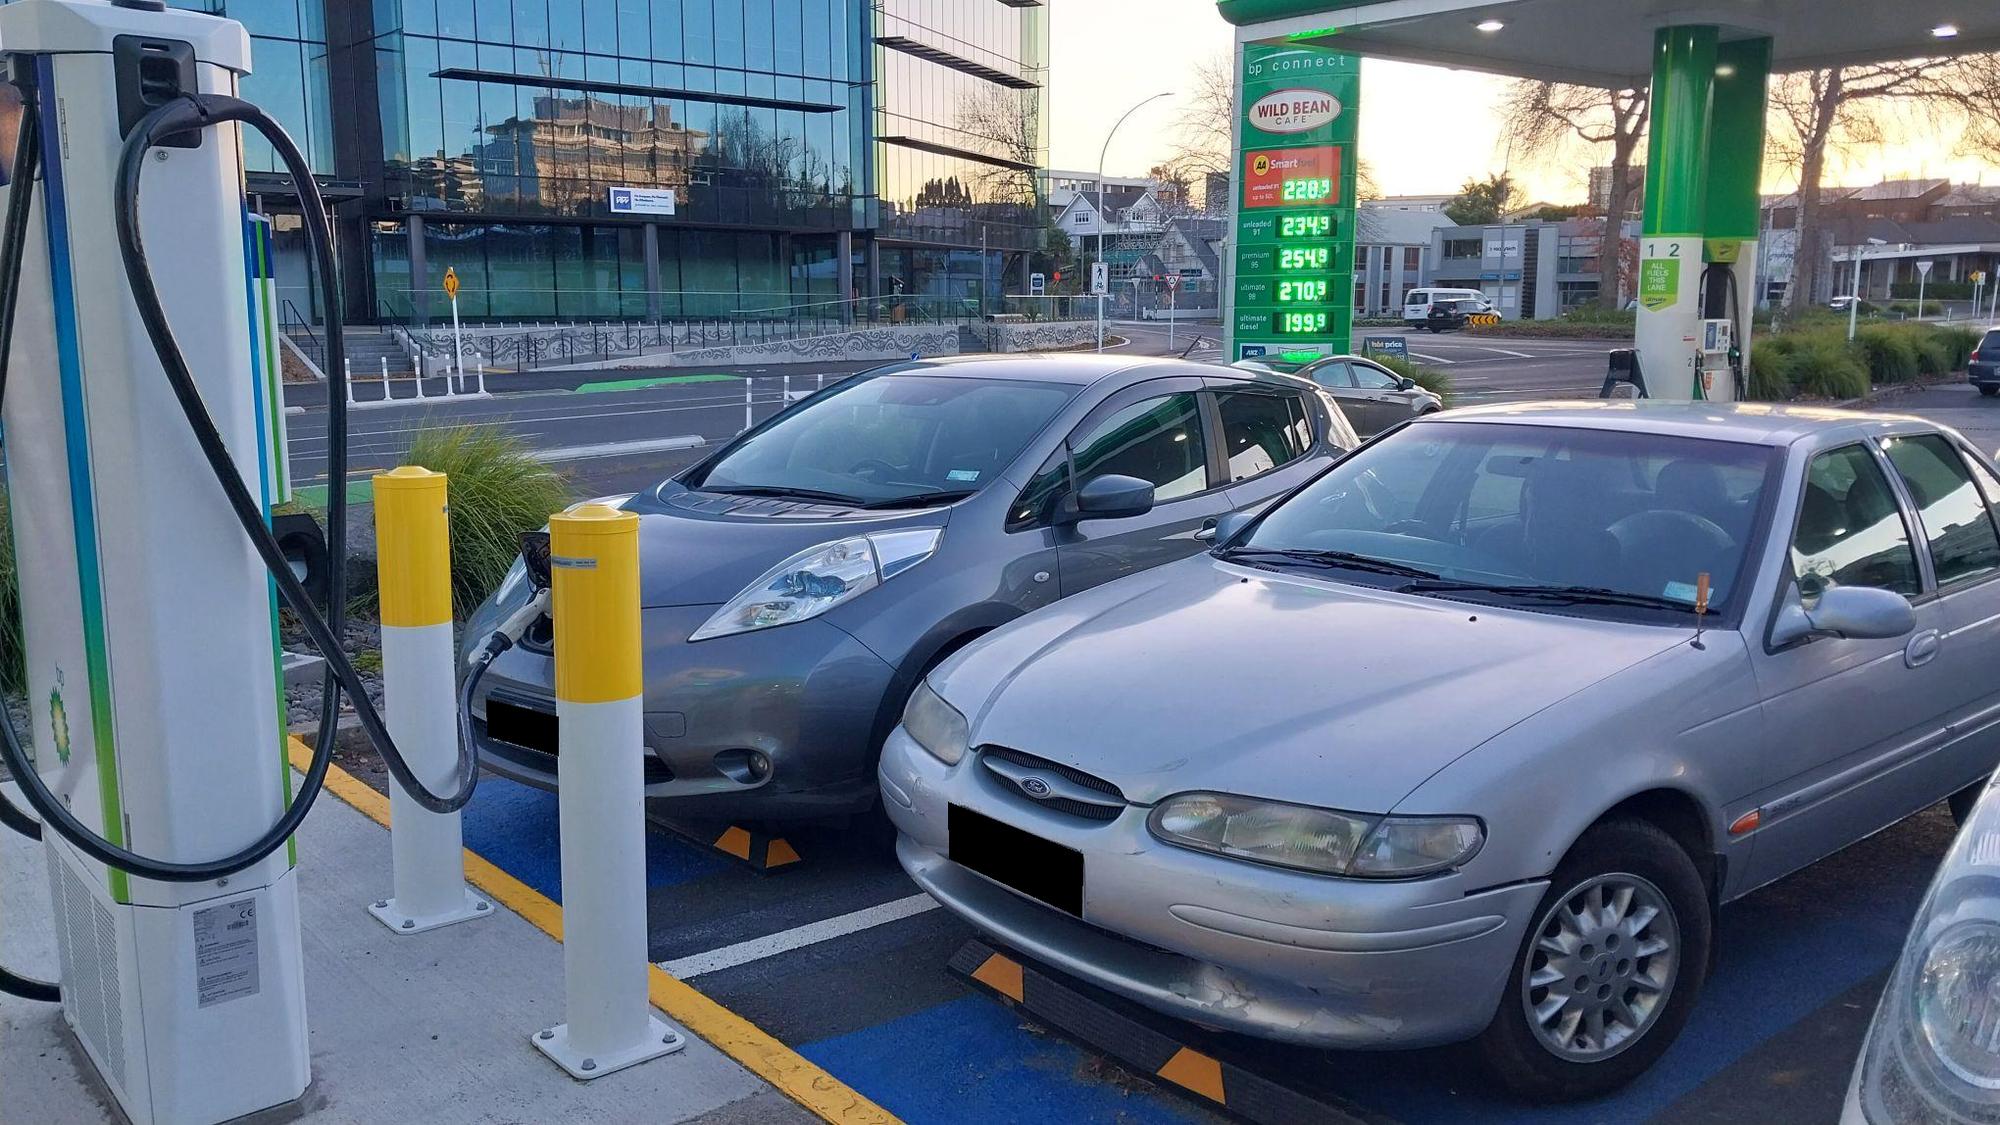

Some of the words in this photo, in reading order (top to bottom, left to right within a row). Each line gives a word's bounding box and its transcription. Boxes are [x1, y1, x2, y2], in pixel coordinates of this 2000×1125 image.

[1248, 64, 1262, 76] bp
[1272, 55, 1345, 71] connect
[1257, 103, 1289, 118] WILD
[1293, 99, 1331, 114] BEAN
[1256, 160, 1267, 170] AA
[1283, 179, 1330, 200] 228.9
[1243, 220, 1272, 228] unleaded
[1282, 216, 1329, 236] 234.9
[1252, 228, 1261, 236] 91
[1241, 252, 1270, 261] premium
[1648, 243, 1655, 257] 1
[1669, 243, 1680, 257] 2
[1250, 260, 1259, 269] 95
[1280, 281, 1327, 301] 270.9
[1285, 313, 1326, 332] 199.9
